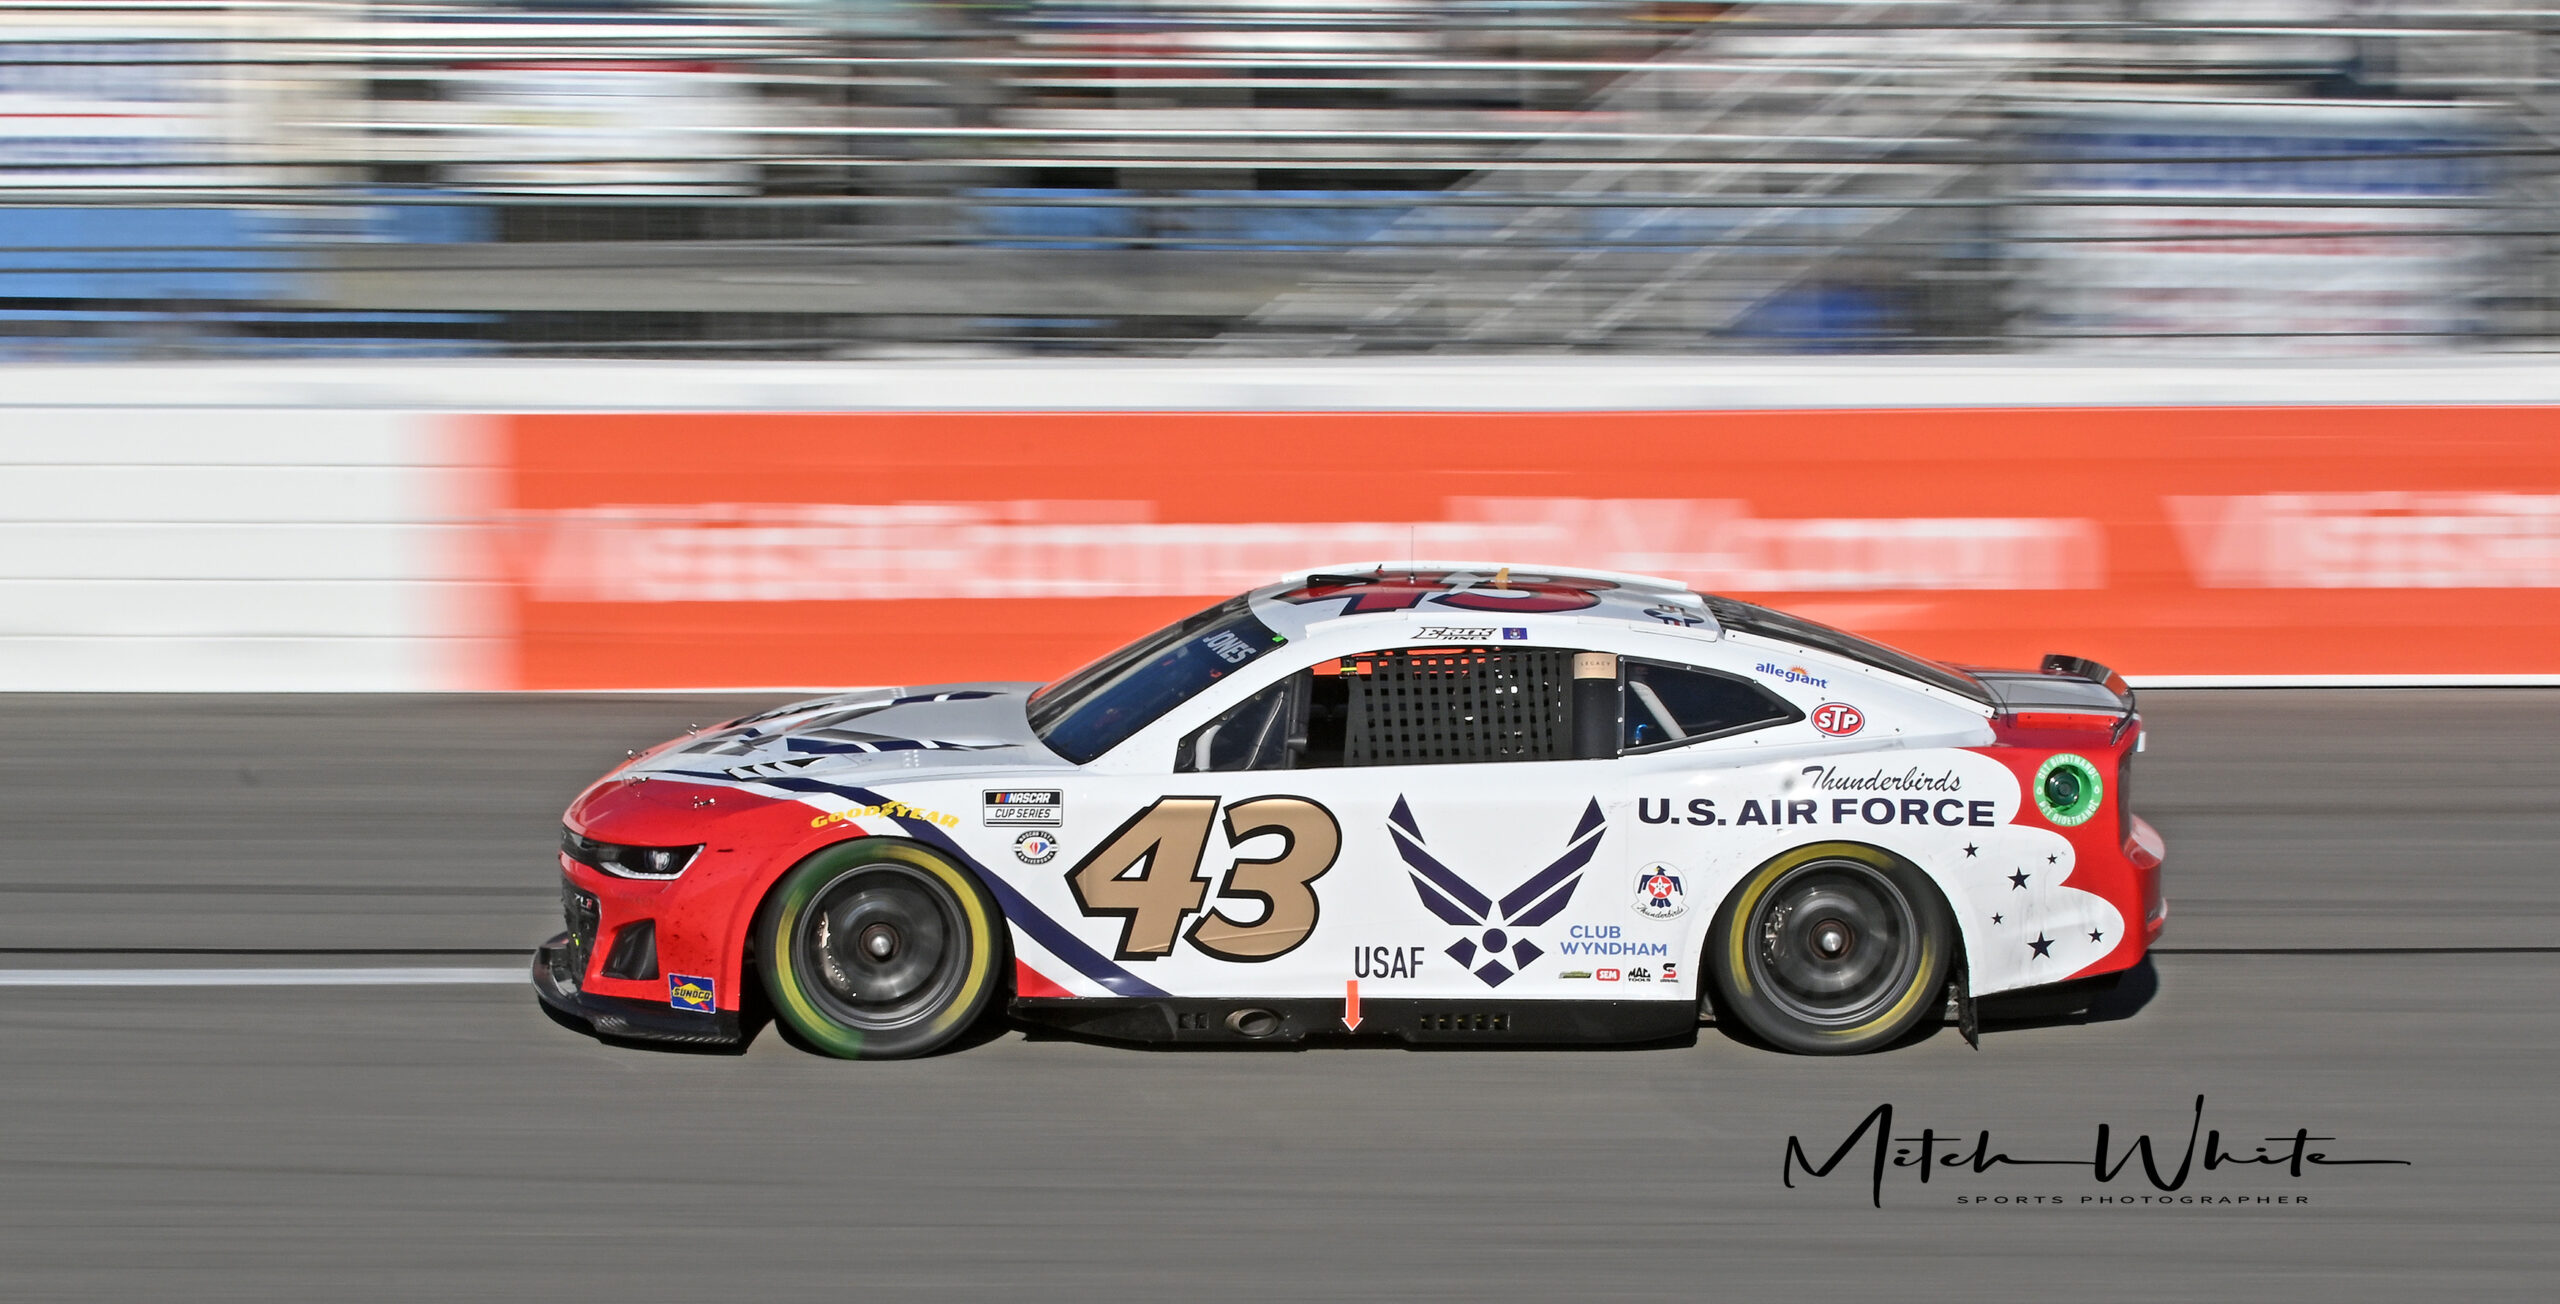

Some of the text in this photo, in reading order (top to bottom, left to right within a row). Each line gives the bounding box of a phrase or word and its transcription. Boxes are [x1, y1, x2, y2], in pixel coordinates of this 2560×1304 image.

[1203, 629, 1257, 664] JONES
[1755, 662, 1829, 689] allegiant
[1818, 706, 1860, 732] STP
[1801, 765, 1961, 793] Thunderbirds
[1008, 792, 1051, 804] NASCAR
[810, 800, 960, 829] GOODYEAR
[995, 808, 1051, 819] CUP SERIES
[1637, 797, 1996, 827] U.S. AIR FORCE
[1063, 794, 1343, 963] 43
[1636, 903, 1684, 919] Thunderbirds
[1570, 925, 1621, 939] CLUB
[1560, 941, 1667, 956] WYNDHAM
[1355, 946, 1425, 979] USAF
[1628, 967, 1651, 978] MAC
[673, 988, 712, 1000] SUNOCO
